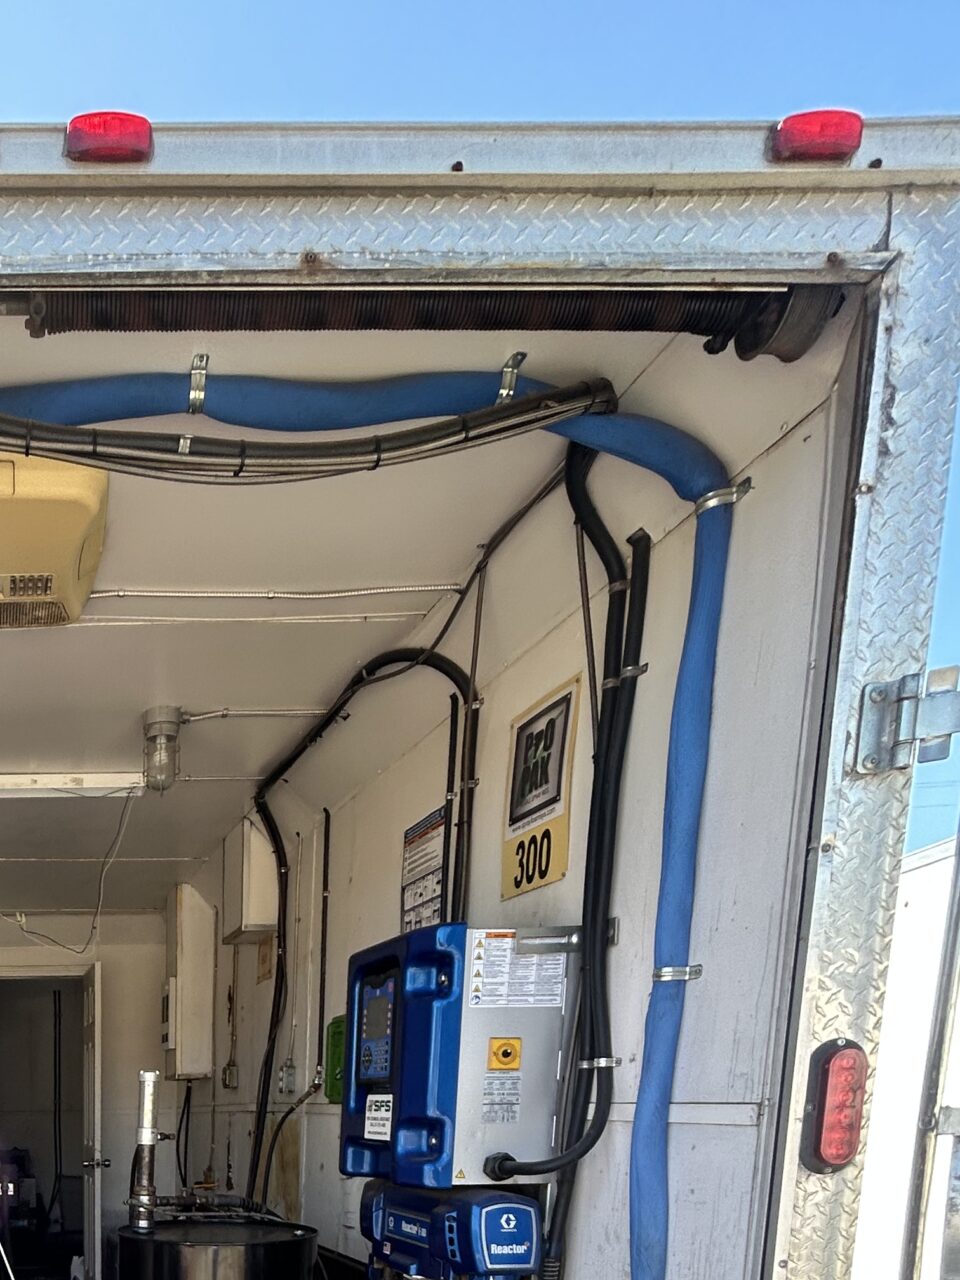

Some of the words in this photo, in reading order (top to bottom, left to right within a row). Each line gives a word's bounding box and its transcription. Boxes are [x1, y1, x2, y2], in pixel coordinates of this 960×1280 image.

[513, 828, 552, 889] 300
[373, 1100, 391, 1112] SFS
[490, 1243, 528, 1254] Reactor
